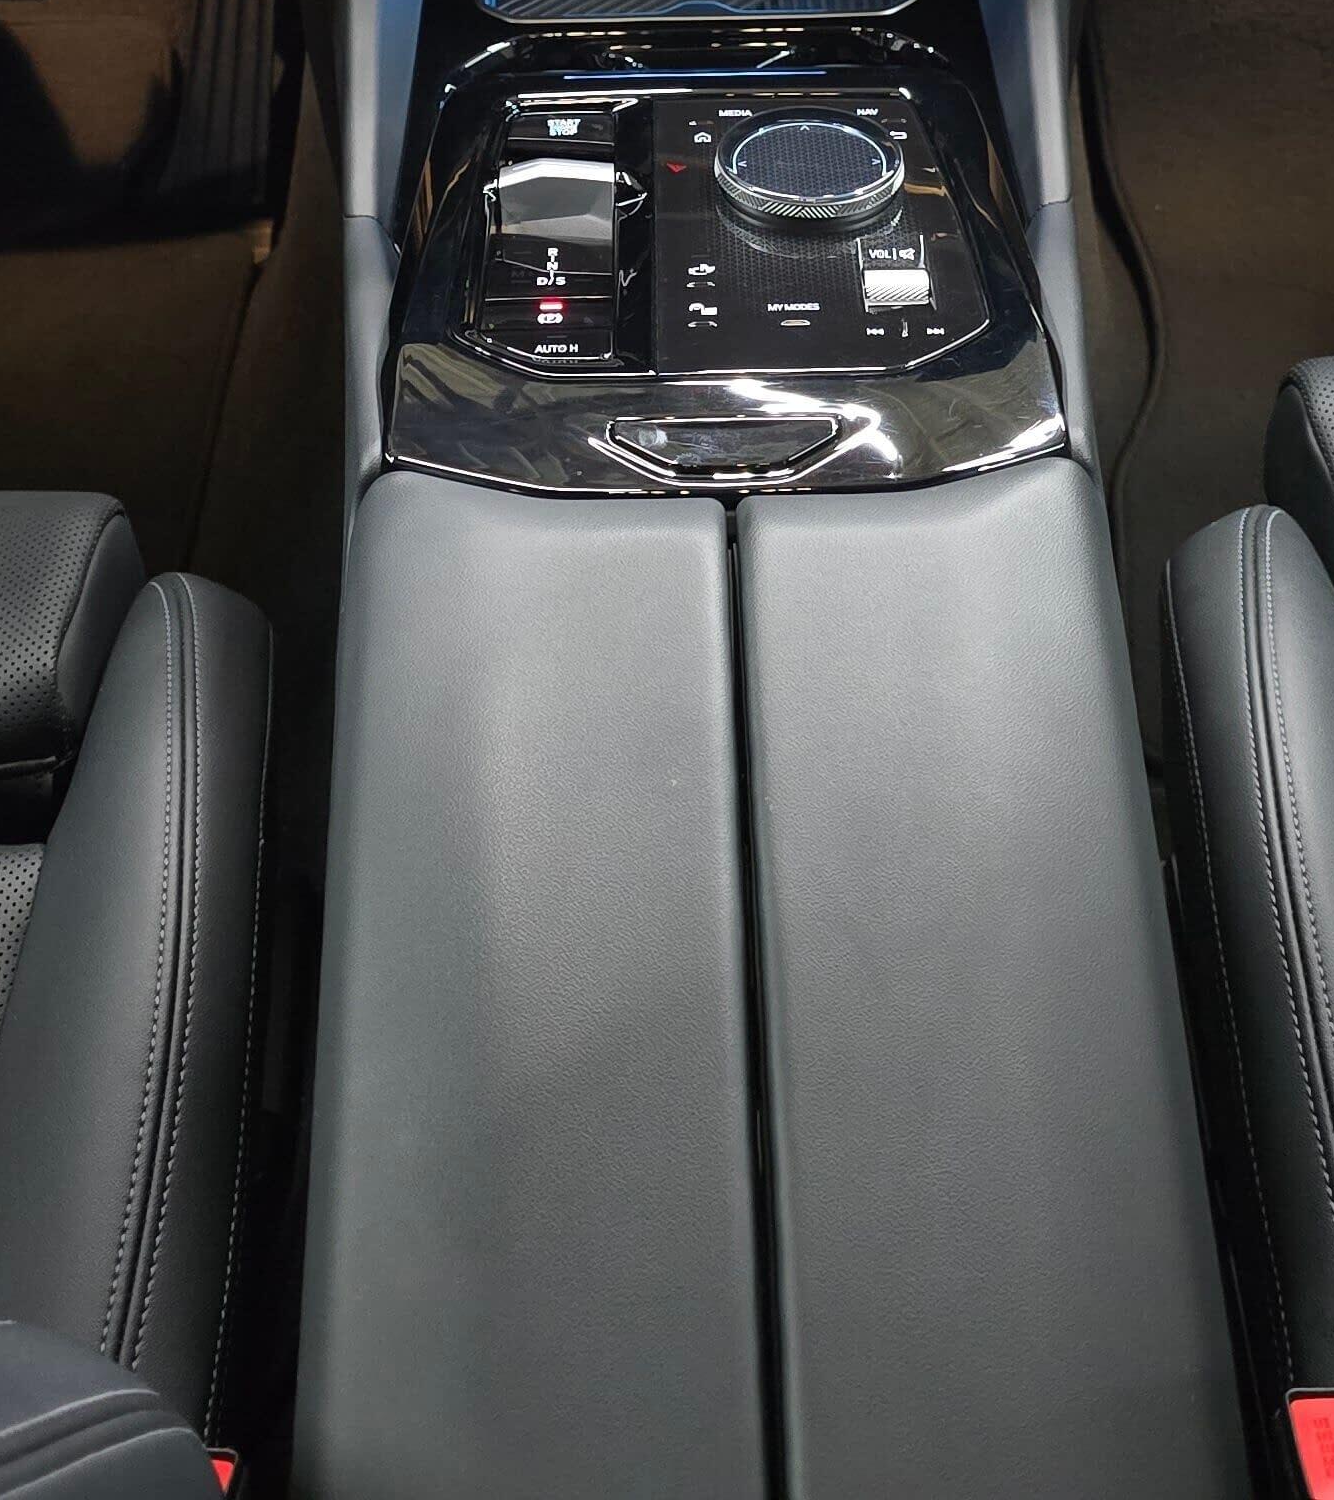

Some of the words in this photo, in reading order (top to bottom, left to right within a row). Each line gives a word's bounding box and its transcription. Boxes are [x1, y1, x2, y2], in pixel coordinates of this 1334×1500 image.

[718, 109, 753, 118] MEDIA
[856, 108, 879, 116] NAV
[868, 249, 892, 260] VOL
[767, 302, 783, 312] MY
[784, 302, 820, 312] MODES
[534, 344, 568, 354] AUTO
[569, 343, 579, 353] H
